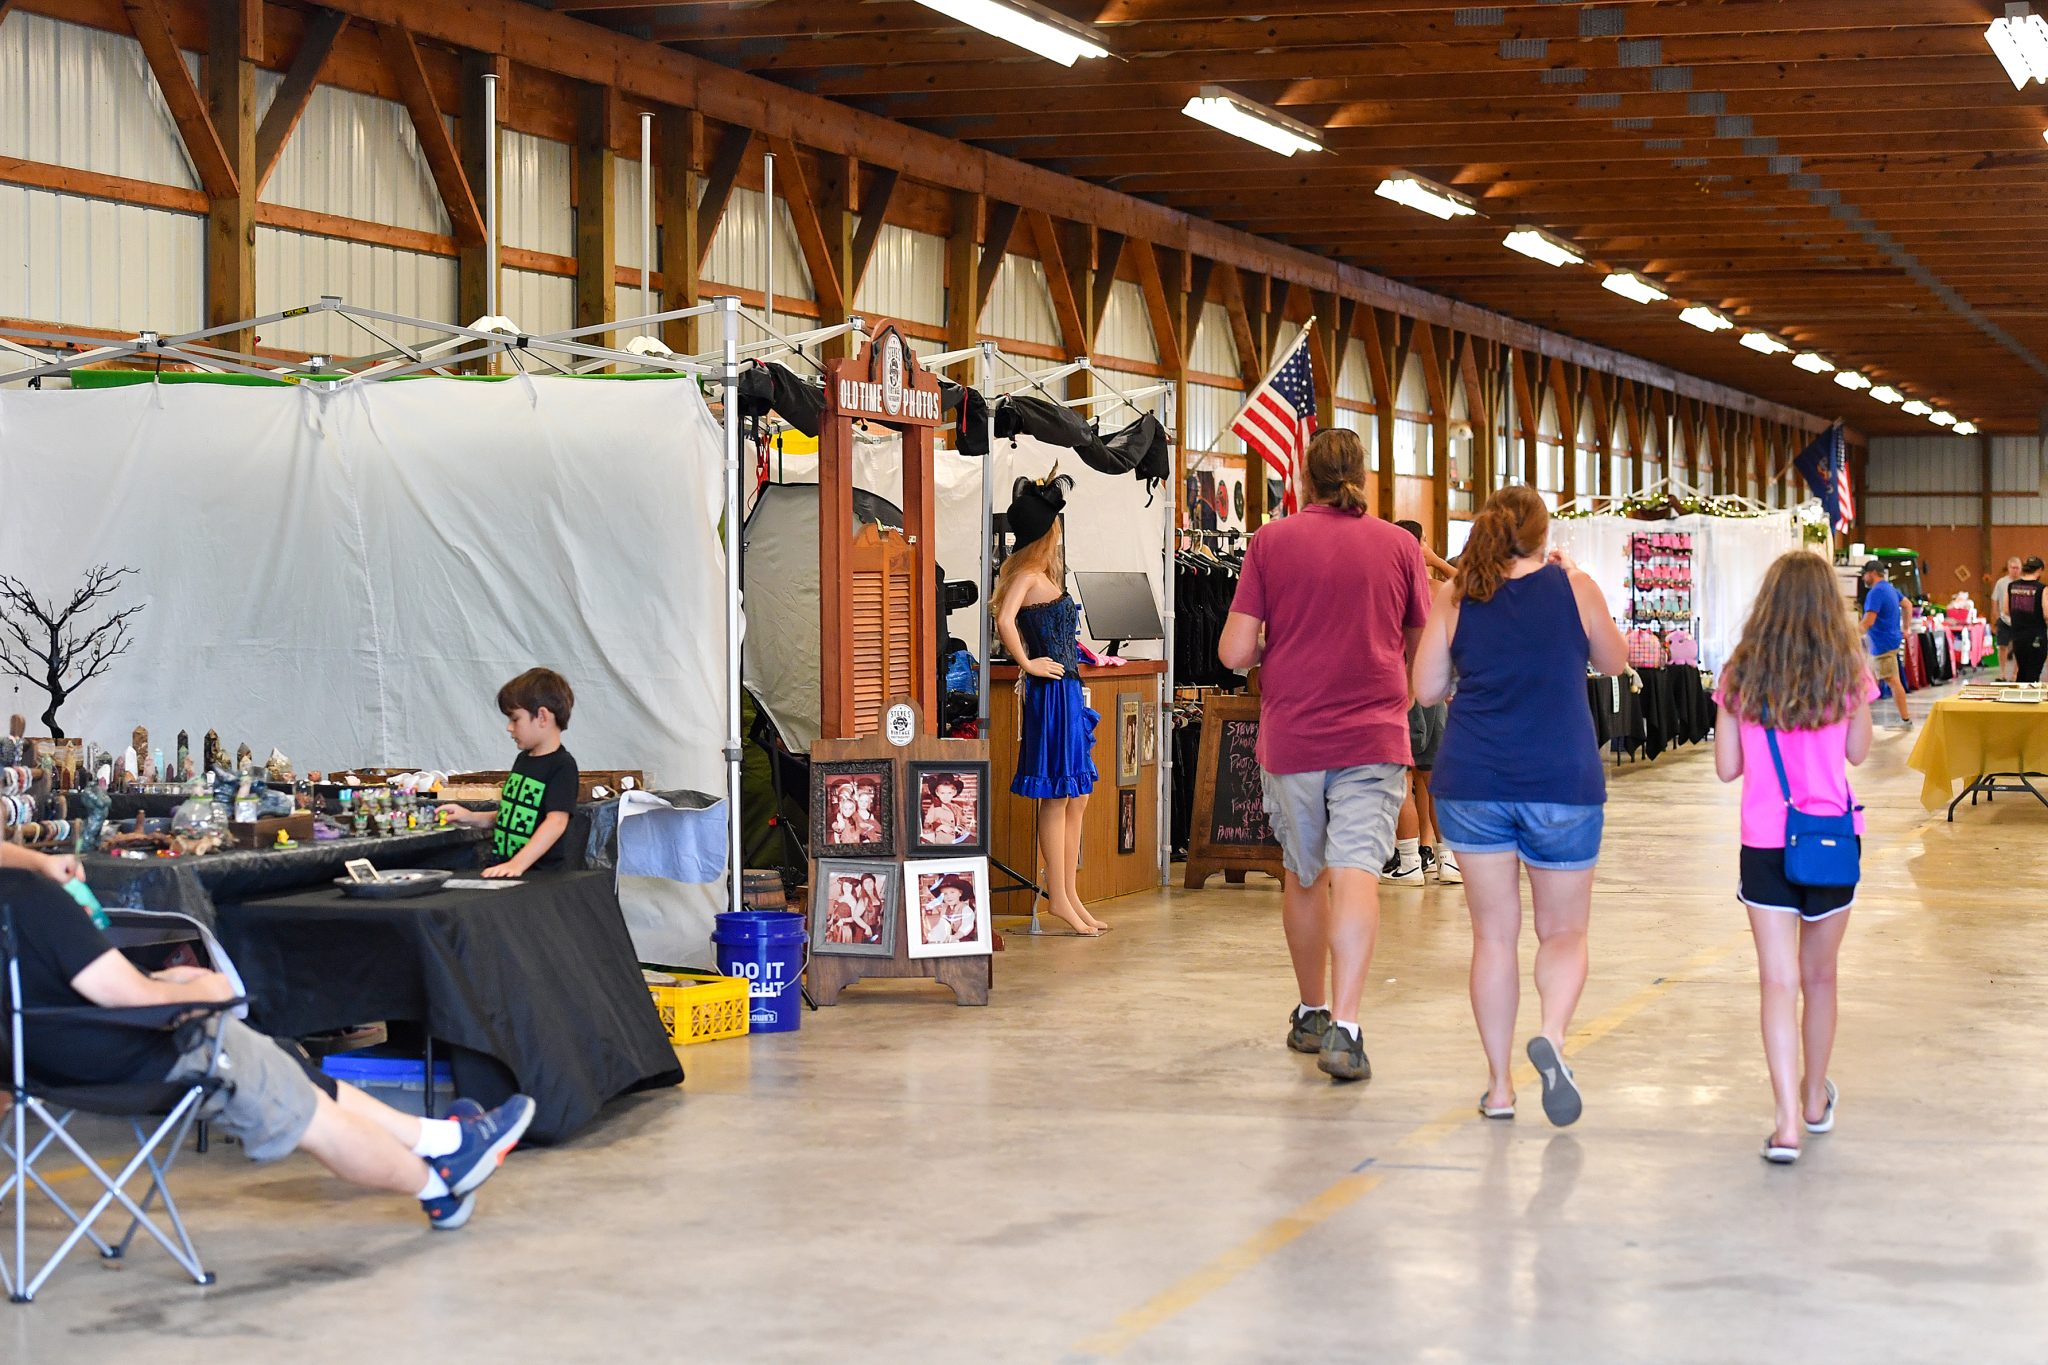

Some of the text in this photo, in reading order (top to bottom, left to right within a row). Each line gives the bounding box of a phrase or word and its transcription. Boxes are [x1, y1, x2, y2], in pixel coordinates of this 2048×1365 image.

[840, 379, 939, 420] OLD TIME PHOTOS
[732, 961, 785, 980] DO IT
[750, 981, 785, 997] GHT
